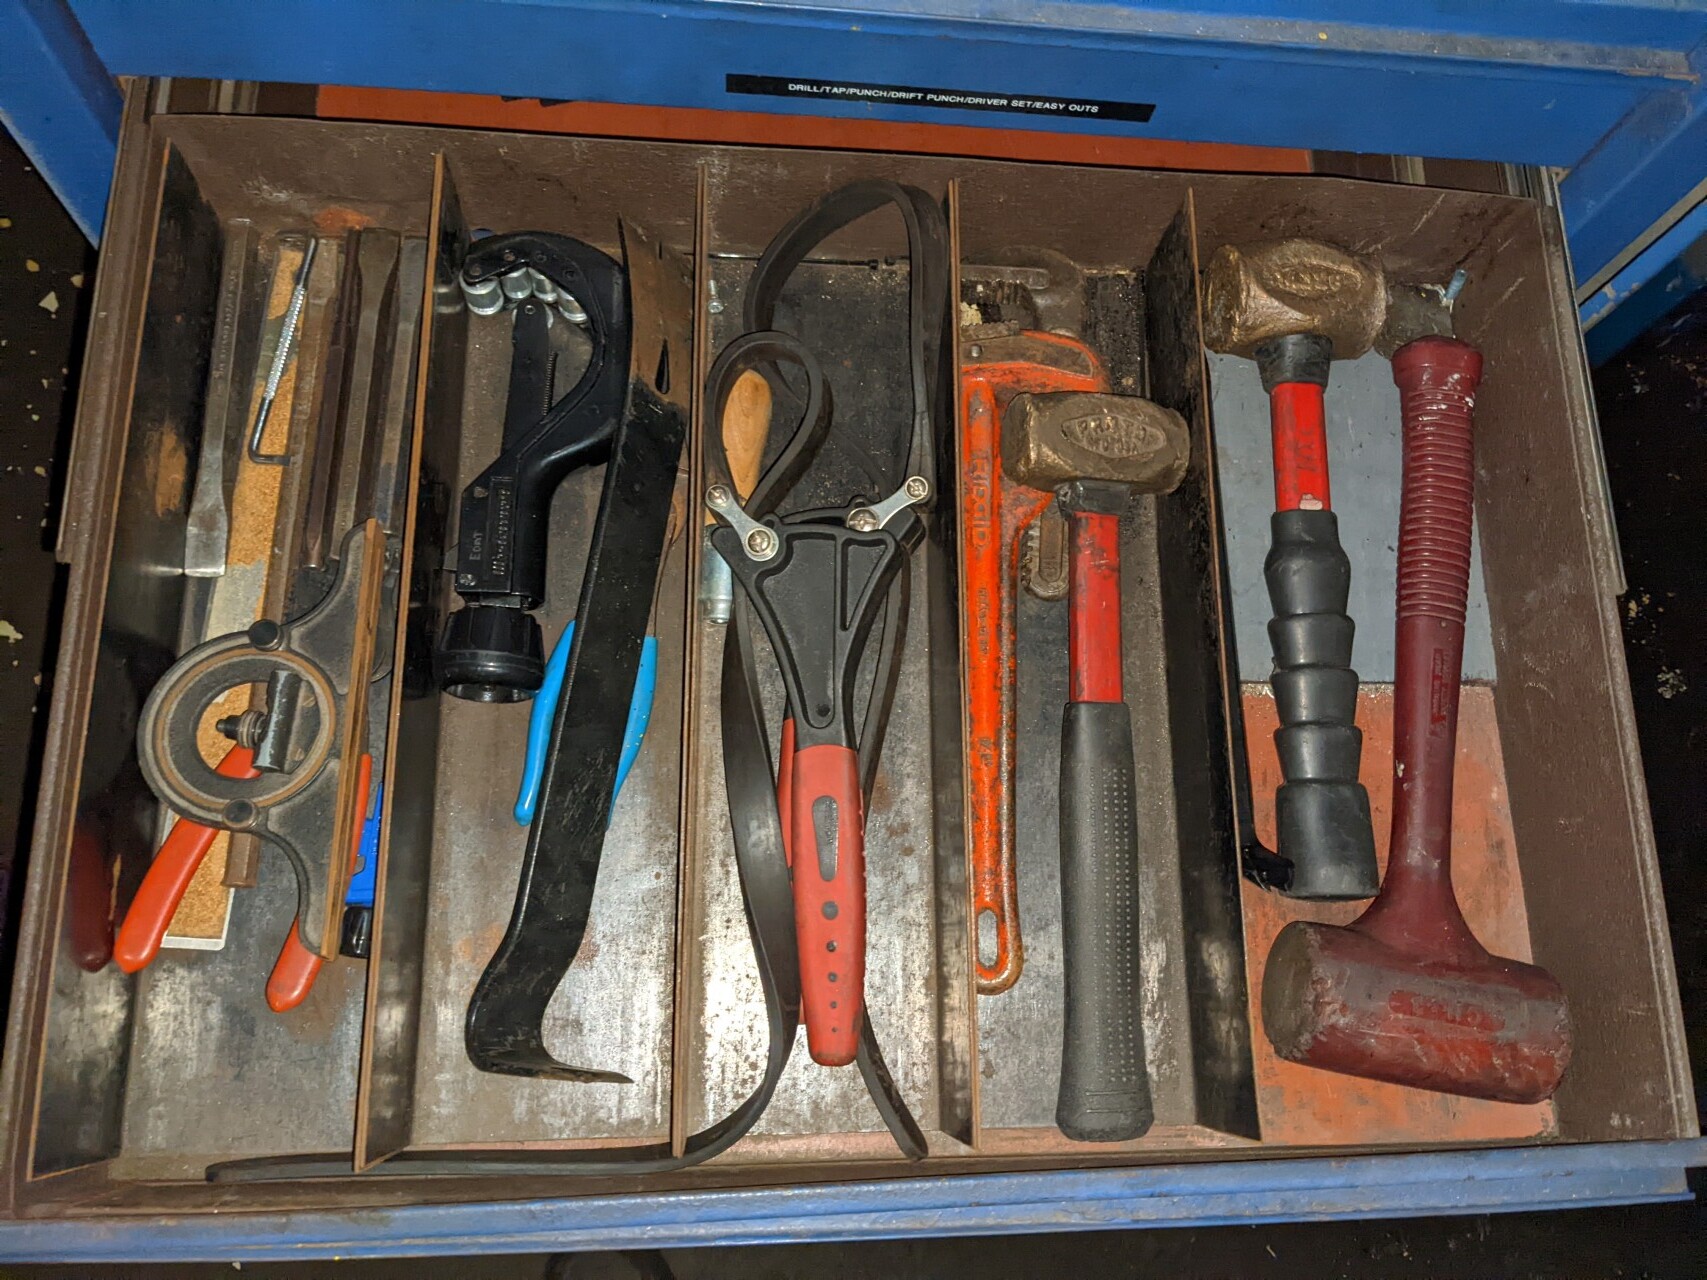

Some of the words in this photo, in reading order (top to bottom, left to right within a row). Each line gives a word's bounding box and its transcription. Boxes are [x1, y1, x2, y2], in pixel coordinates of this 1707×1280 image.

[788, 83, 924, 101] DRILL/TAP/PUNCH/DRIFT
[926, 93, 1008, 106] PUNCH/DRIVER
[1011, 99, 1066, 111] SET/EASY
[1068, 104, 1099, 114] OUTS
